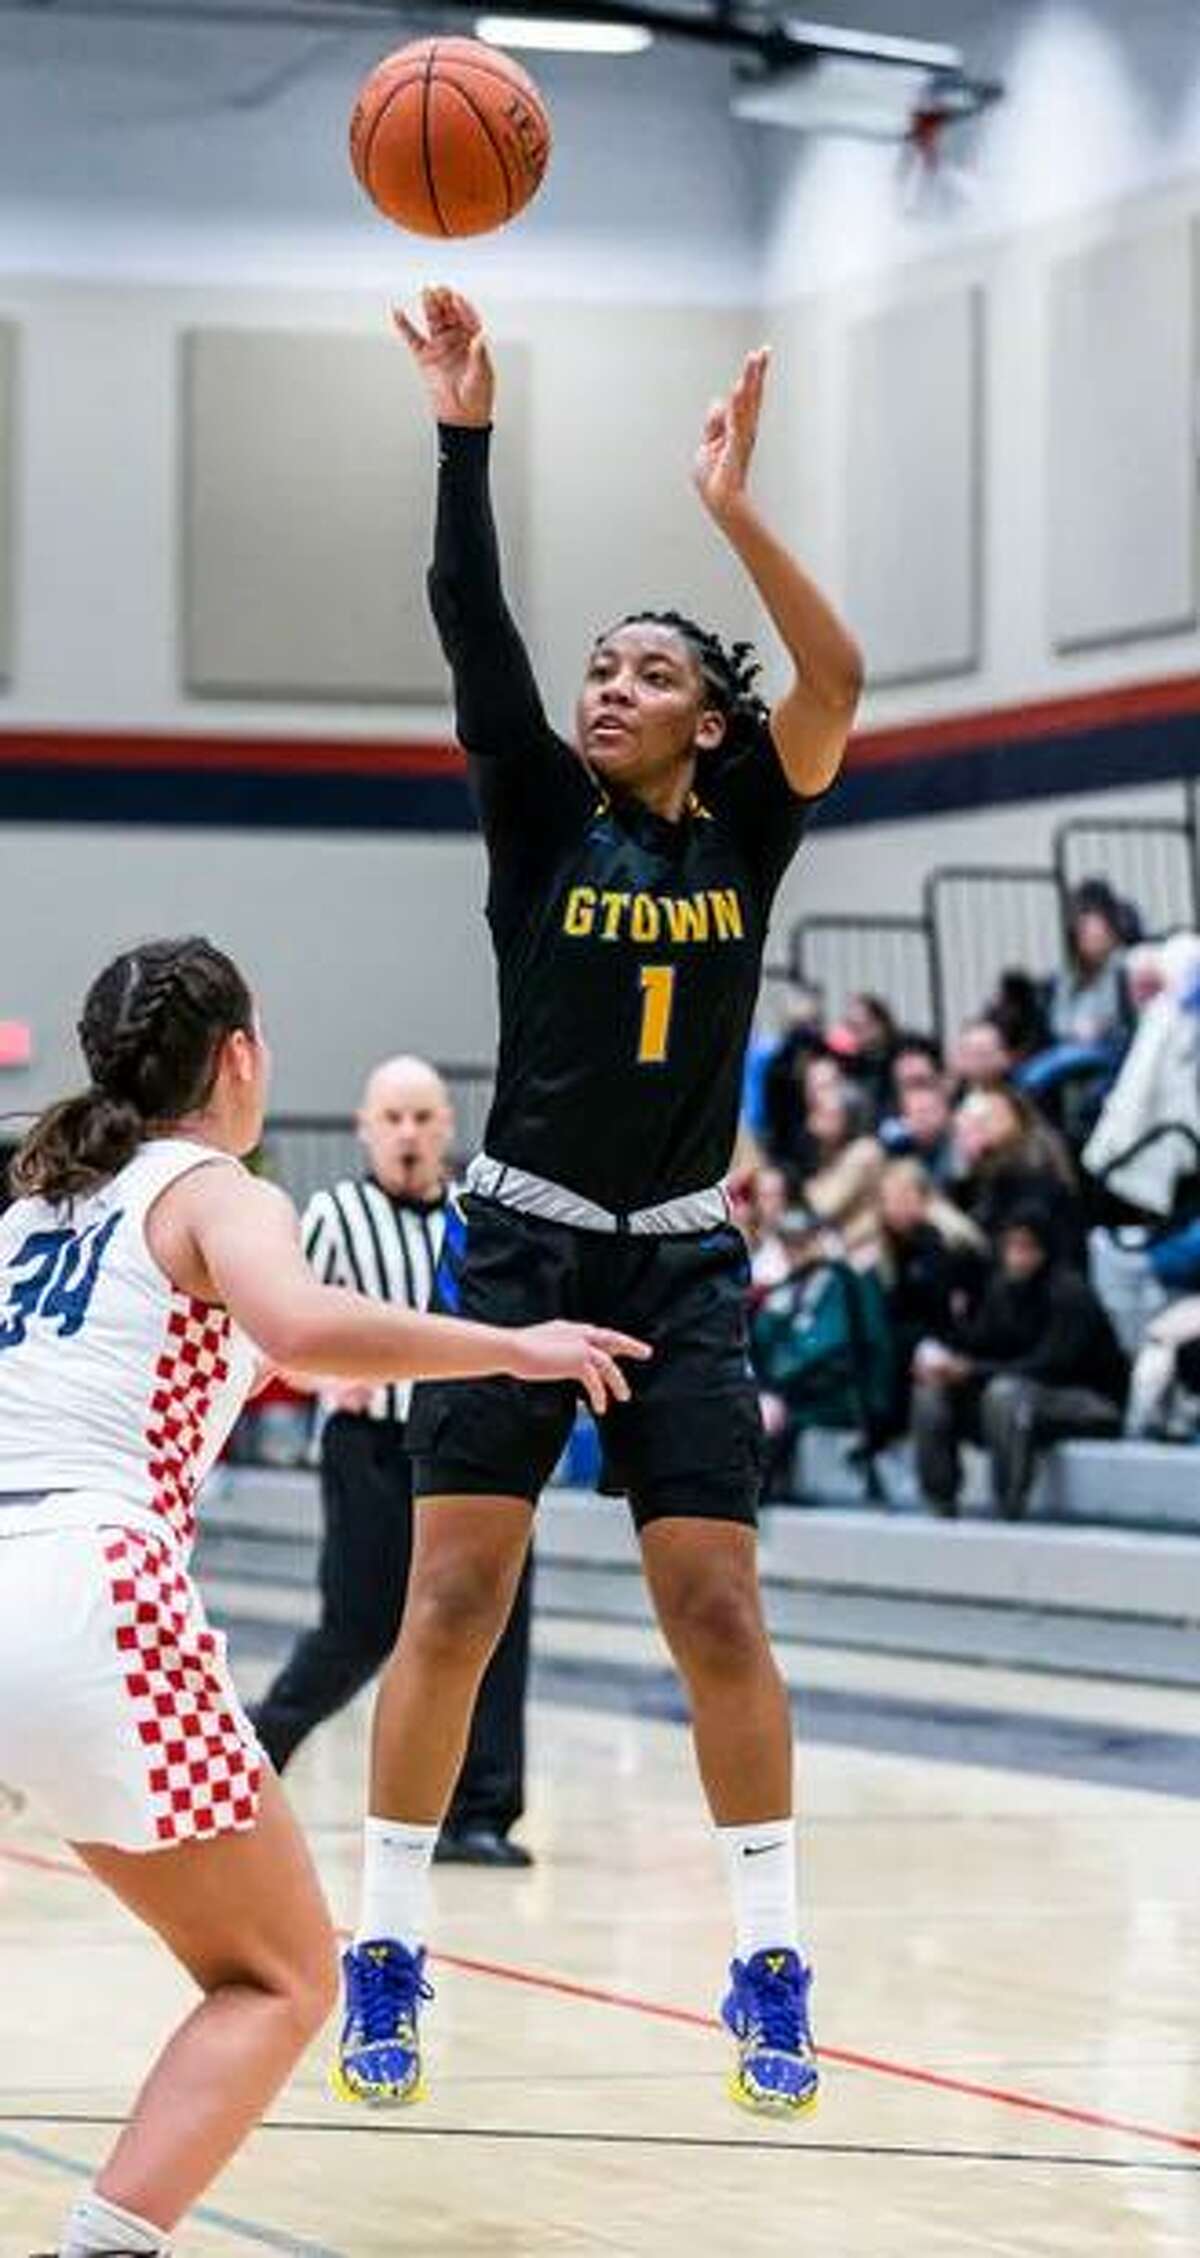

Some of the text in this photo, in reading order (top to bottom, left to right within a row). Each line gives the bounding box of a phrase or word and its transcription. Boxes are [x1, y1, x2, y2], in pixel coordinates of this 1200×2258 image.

[563, 886, 745, 942] GTOWN
[638, 965, 675, 1063] 1
[0, 1209, 124, 1348] 34
